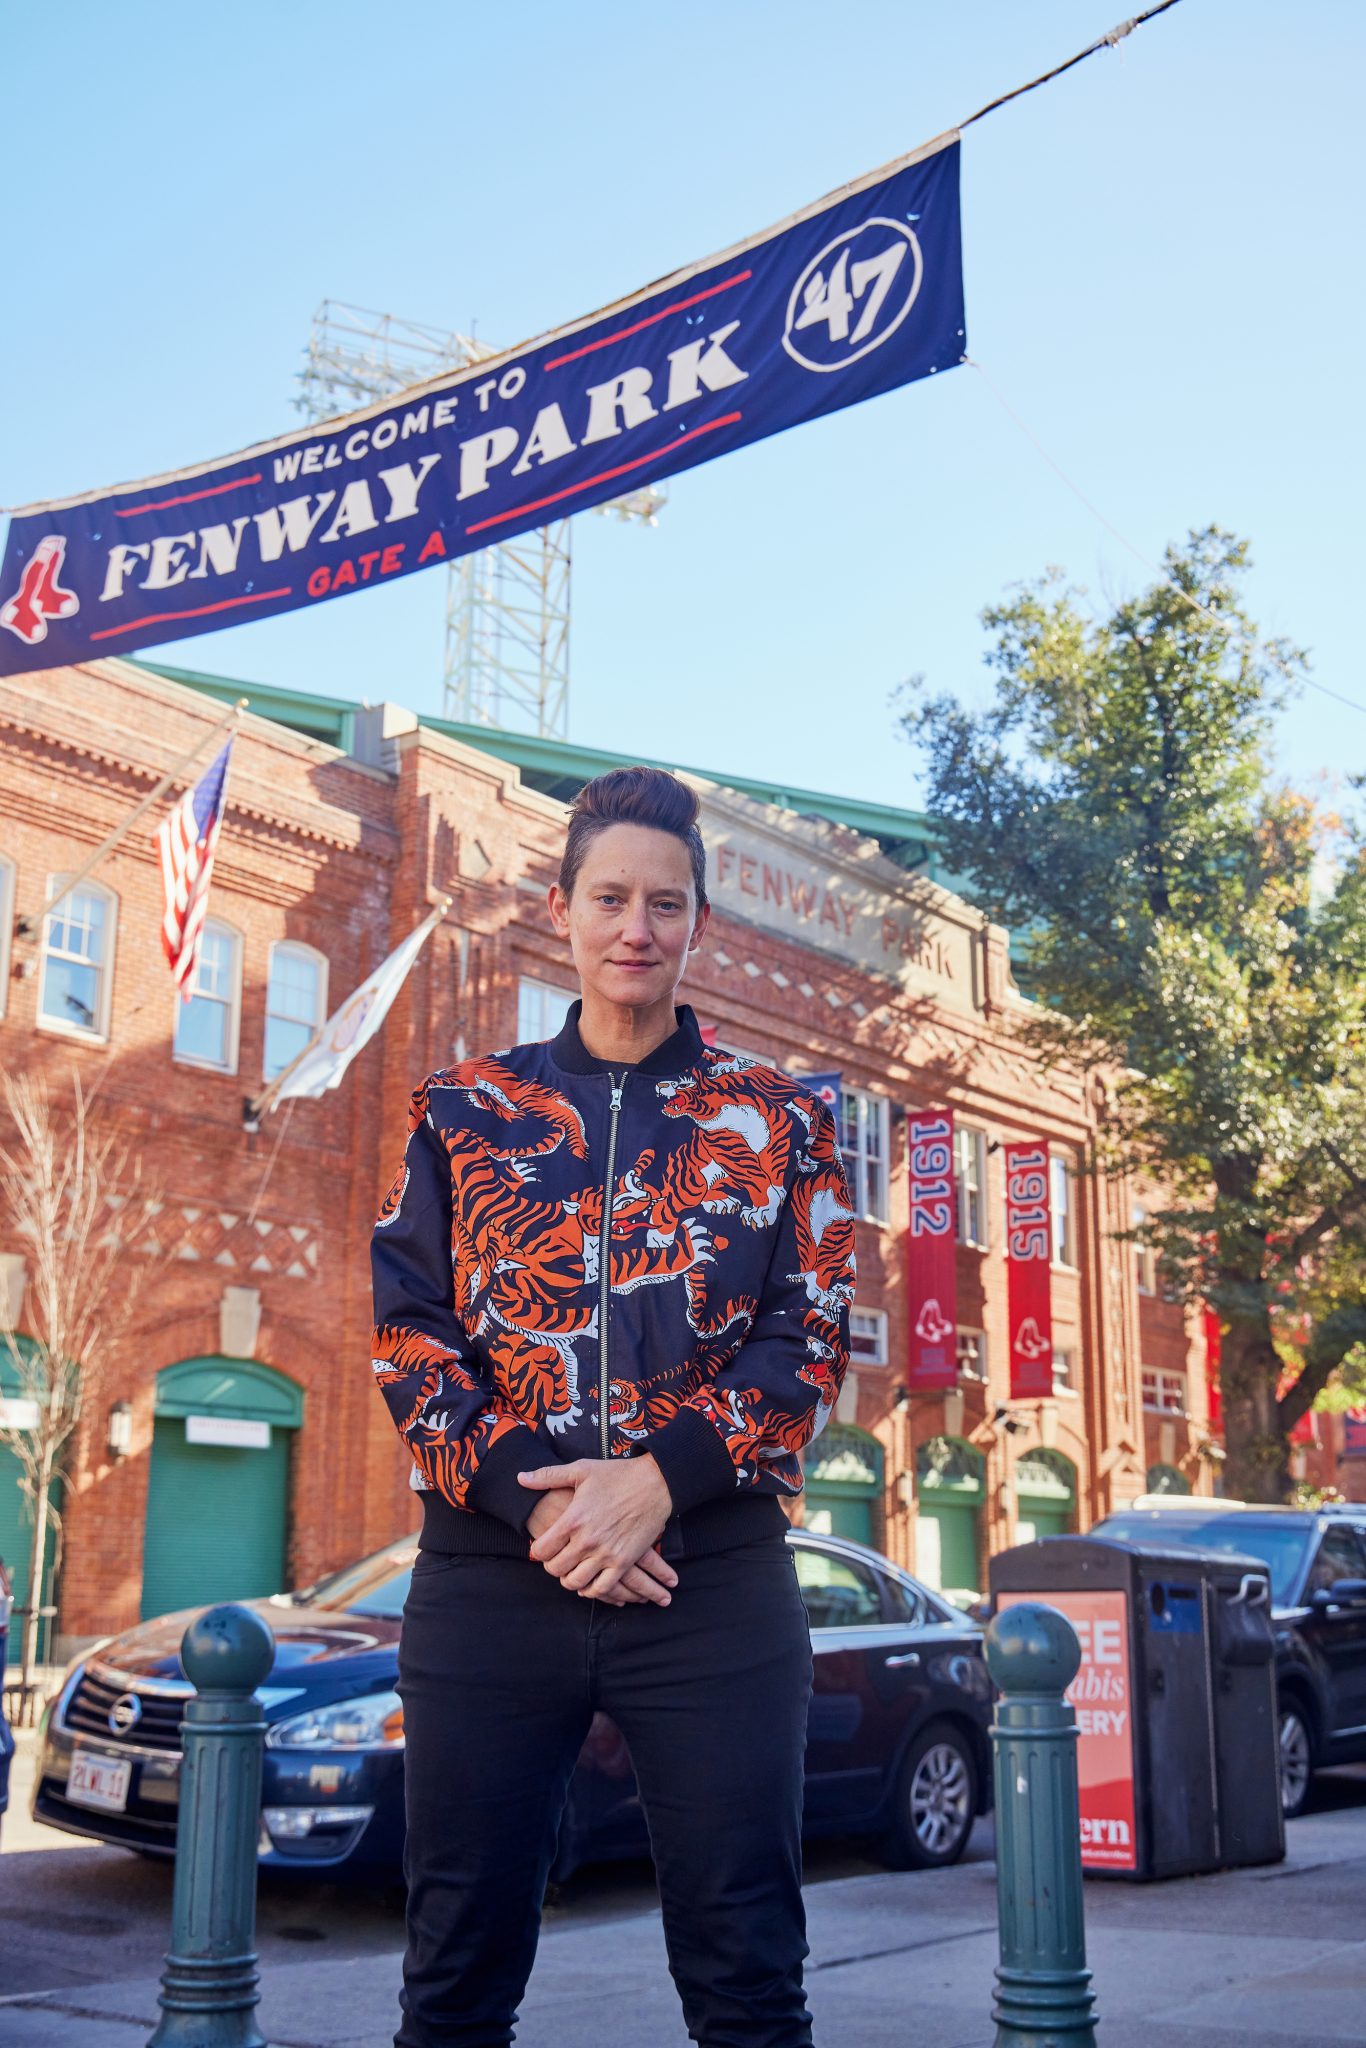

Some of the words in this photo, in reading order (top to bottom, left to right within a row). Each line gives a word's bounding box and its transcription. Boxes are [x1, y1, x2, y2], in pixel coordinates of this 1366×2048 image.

[100, 453, 442, 602] FENWAY
[457, 320, 749, 500] PARK
[272, 397, 457, 483] WELCOME
[474, 367, 527, 412] TO
[307, 544, 405, 598] GATE
[418, 531, 447, 562] A
[717, 844, 857, 936] FENWAY
[910, 1119, 952, 1237] 1912
[1007, 1150, 1049, 1262] 1915
